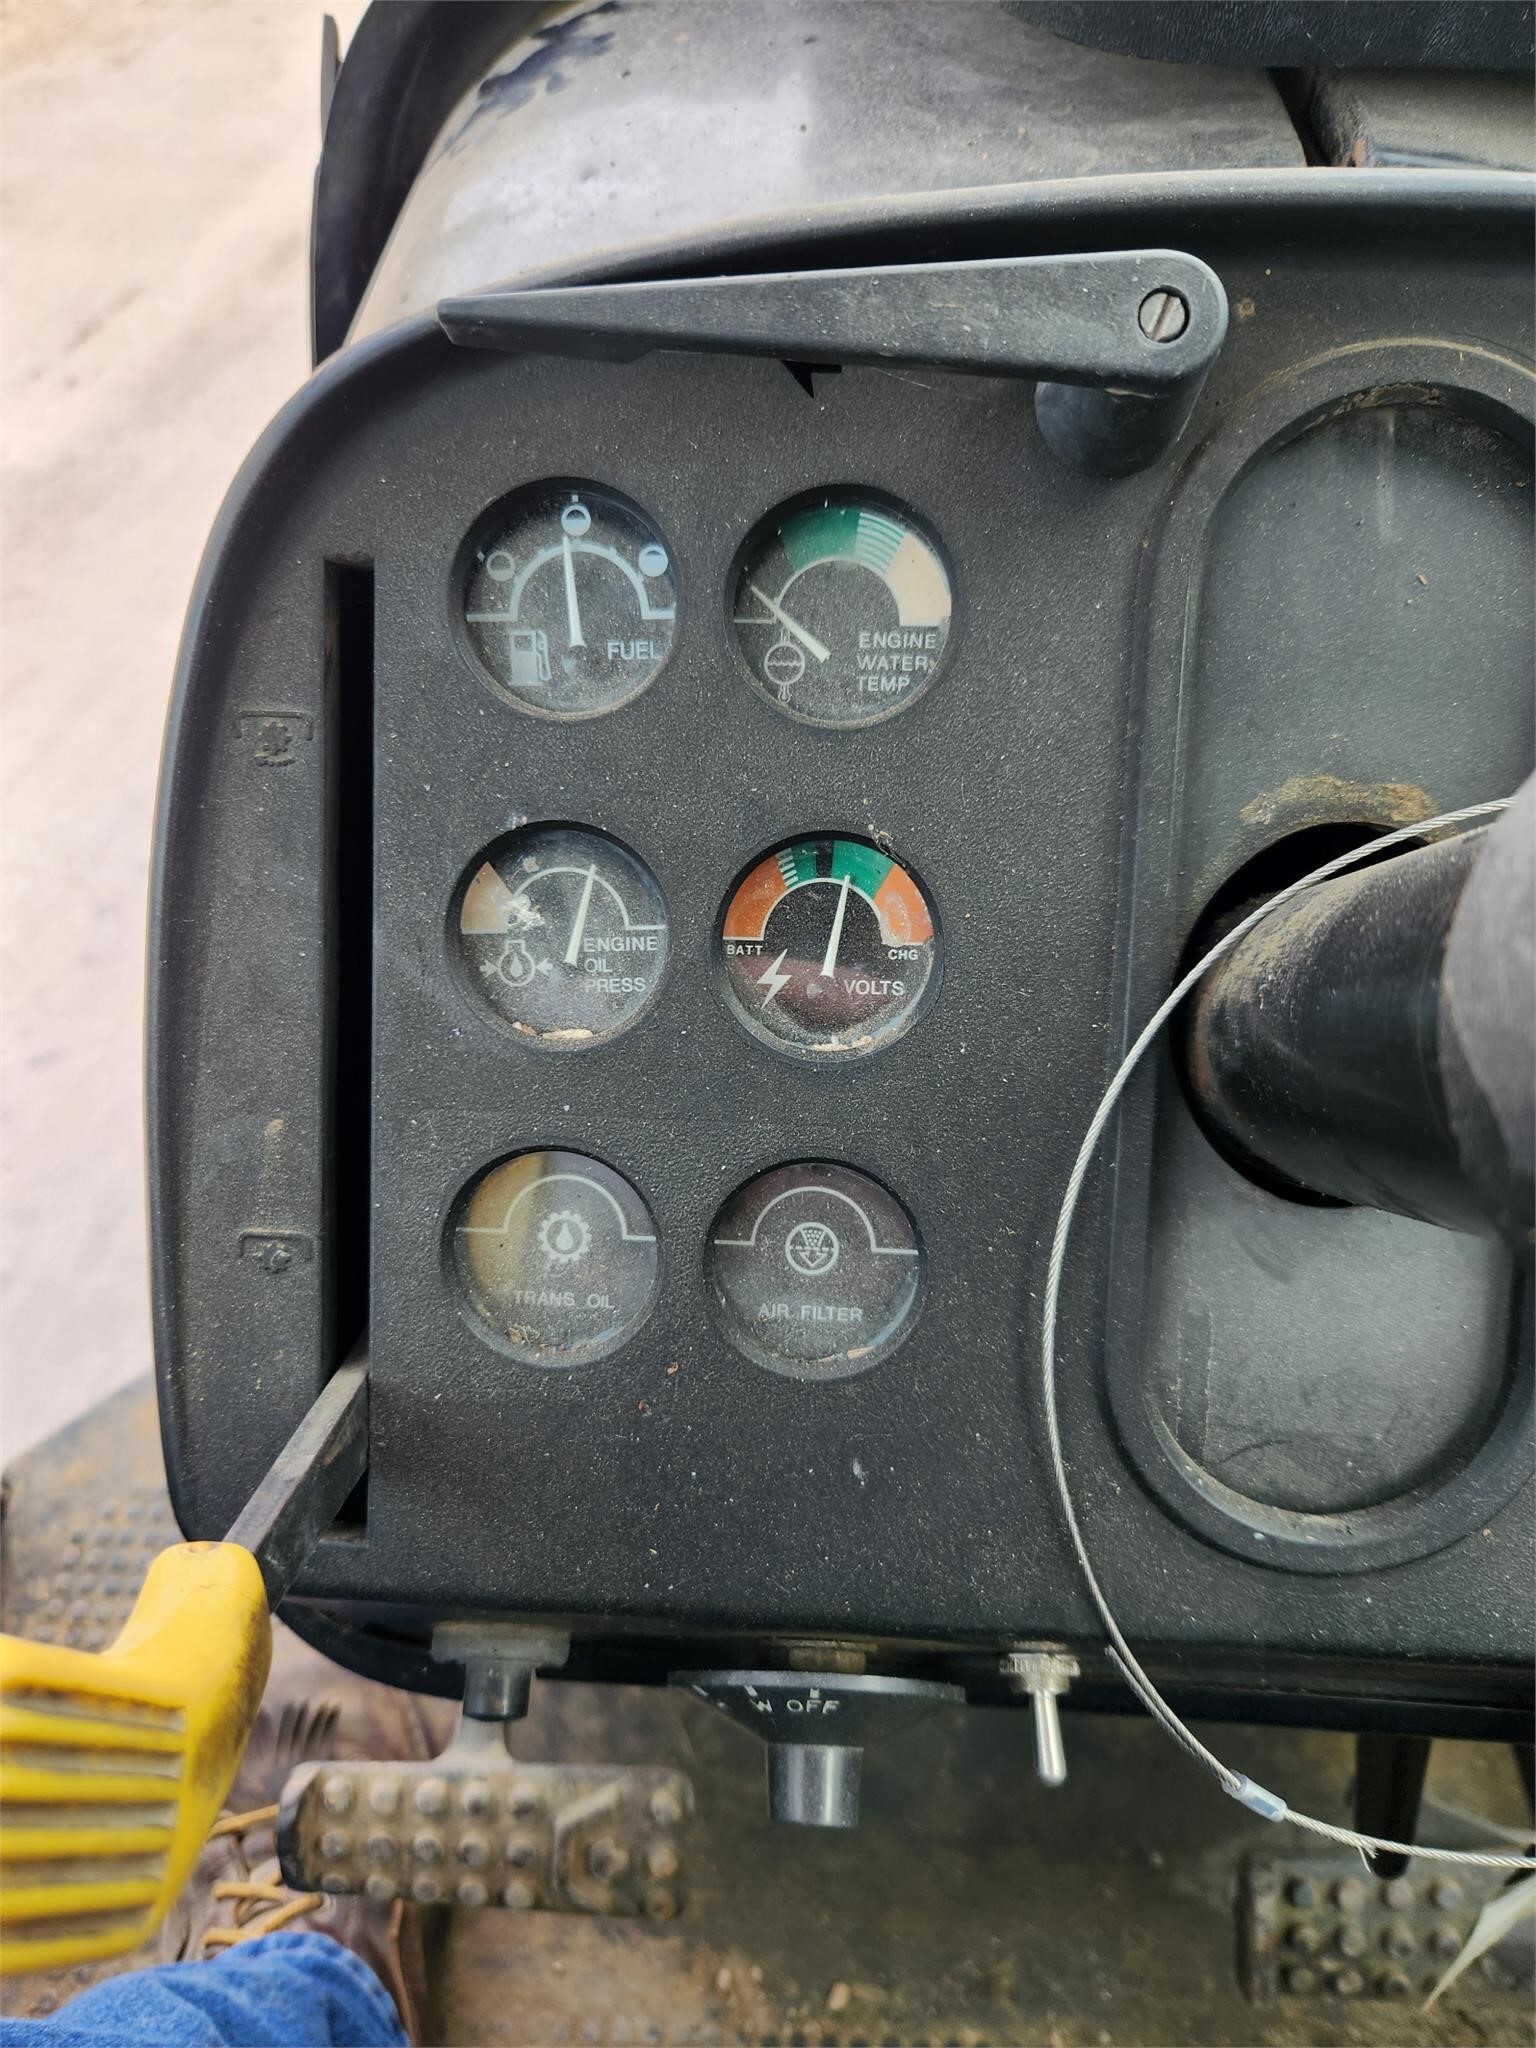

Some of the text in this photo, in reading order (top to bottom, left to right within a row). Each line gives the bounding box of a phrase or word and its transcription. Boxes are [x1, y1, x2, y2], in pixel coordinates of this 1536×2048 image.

[859, 631, 936, 649] ENGINE
[606, 639, 662, 660] FUEL
[856, 654, 928, 672] WATER
[857, 675, 911, 692] TEMP
[583, 936, 658, 952] ENGINE
[726, 944, 764, 956] BATT
[888, 949, 918, 961] CHG
[585, 957, 613, 973] OIL
[585, 976, 646, 993] PRESS
[844, 979, 905, 996] VOLTS
[514, 1290, 615, 1309] TRANS OIL
[758, 1303, 864, 1322] AIR FILTER
[786, 1699, 840, 1714] OFF
